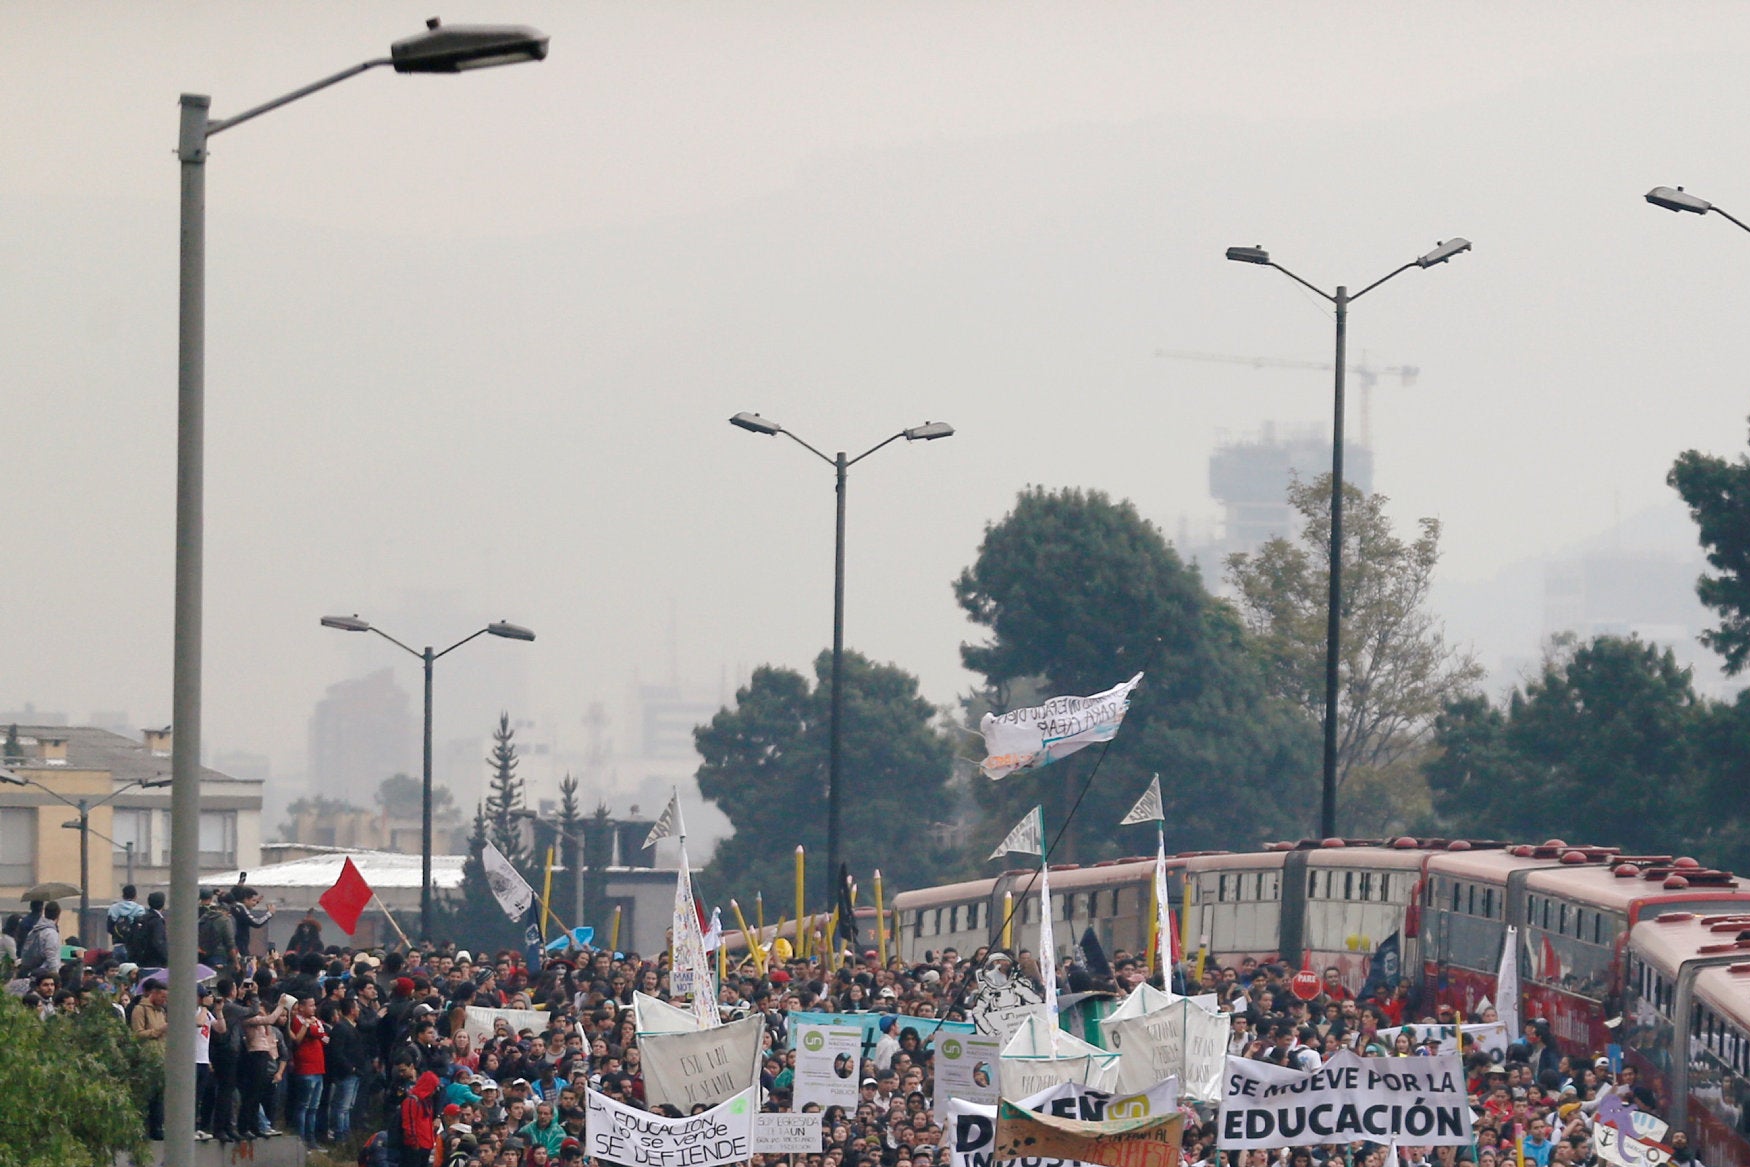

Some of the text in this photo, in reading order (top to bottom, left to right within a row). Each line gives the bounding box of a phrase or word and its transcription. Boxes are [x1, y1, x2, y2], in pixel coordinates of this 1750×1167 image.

[805, 1036, 822, 1046] un
[943, 1044, 961, 1054] un
[1229, 1067, 1456, 1098] SE MUEVE POR LA
[1224, 1097, 1464, 1139] EDUCACIÓN
[640, 1137, 664, 1149] se
[673, 1123, 728, 1146] vende
[596, 1134, 748, 1167] SE DEFIENDE
